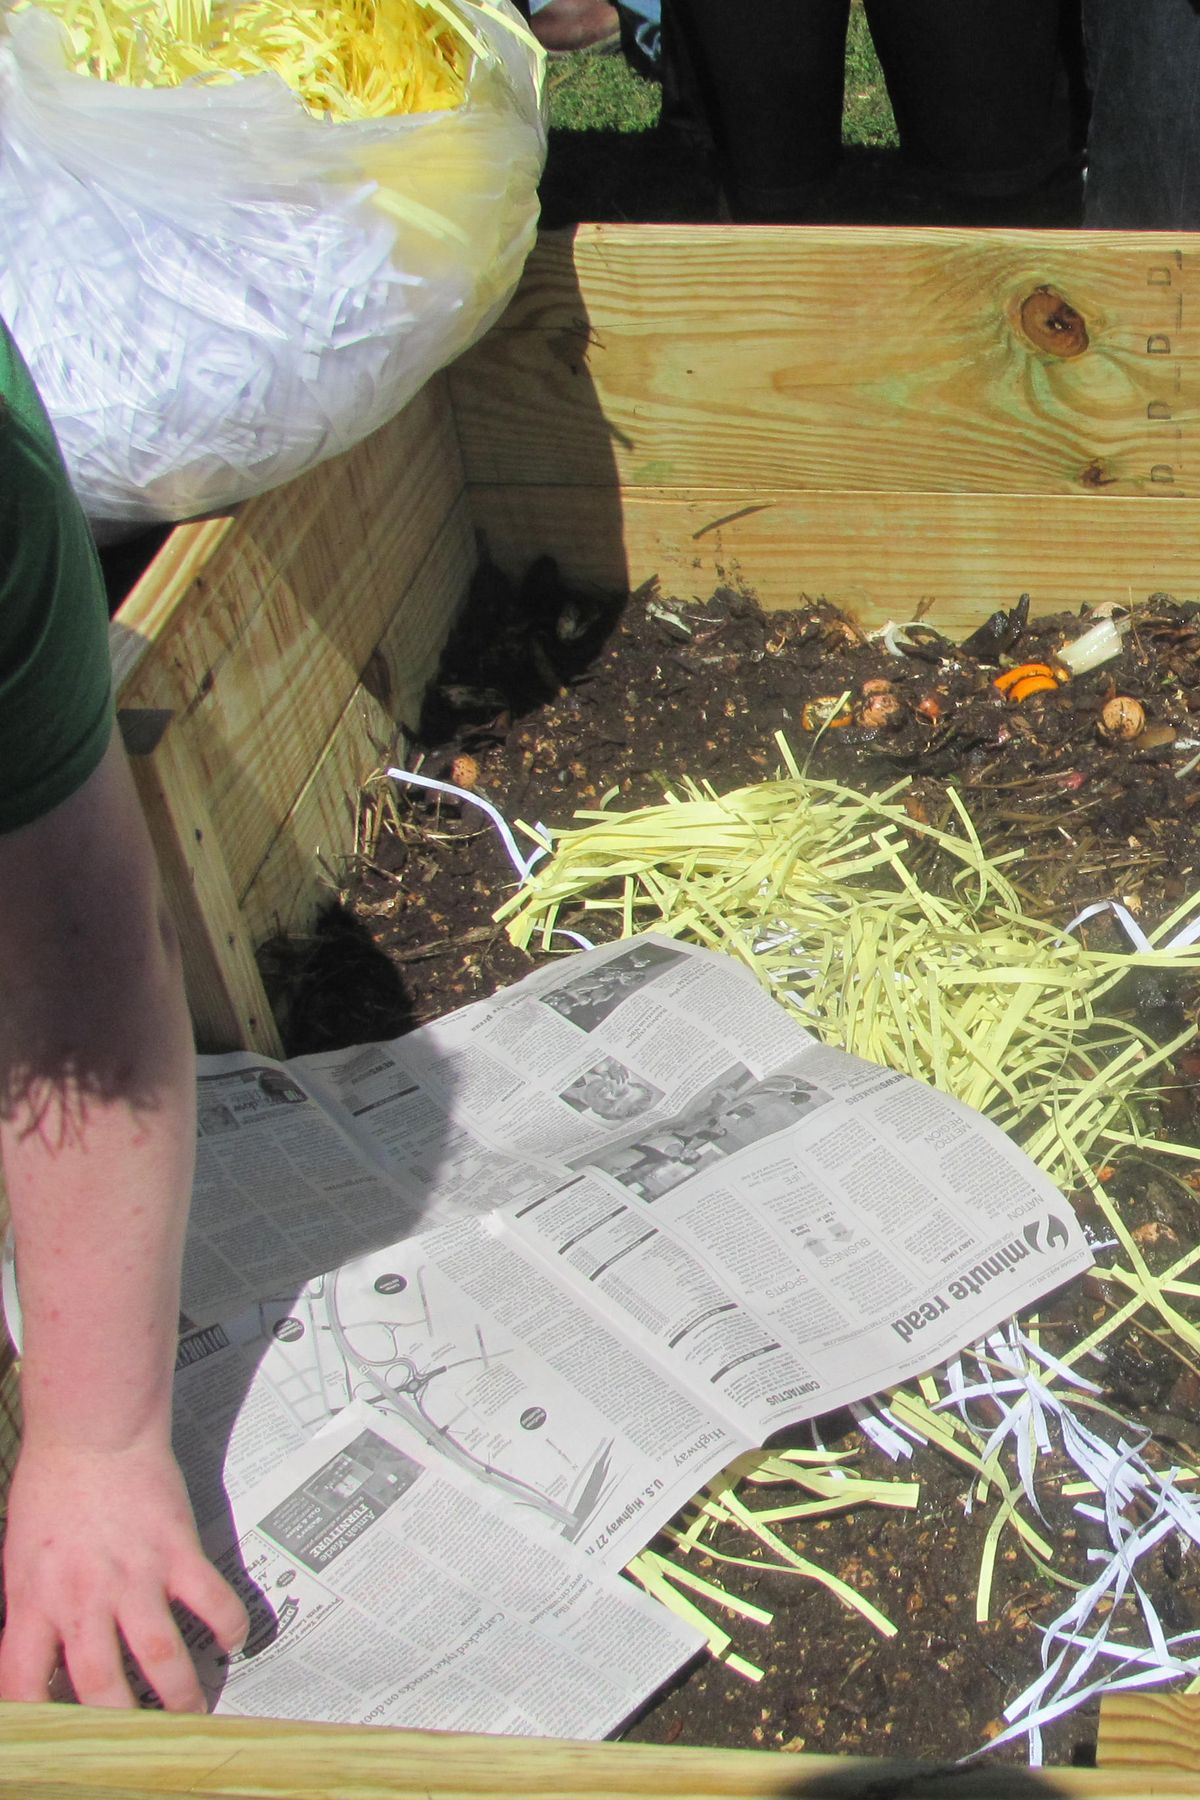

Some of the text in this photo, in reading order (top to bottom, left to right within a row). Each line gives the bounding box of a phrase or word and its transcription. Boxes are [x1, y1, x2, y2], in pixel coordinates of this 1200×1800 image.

[844, 1072, 905, 1106] NEWSMAKERS
[923, 1115, 963, 1143] REGION
[1006, 1193, 1044, 1221] NATION
[818, 1237, 871, 1268] BUSINESS
[763, 1273, 808, 1299] SPORTS
[945, 1237, 1032, 1307] minute
[889, 1293, 951, 1344] read
[765, 1379, 821, 1407] CONTACTUS
[671, 1426, 726, 1467] Highway
[640, 1477, 664, 1501] U.S.
[306, 1506, 321, 1519] Oak
[343, 1509, 376, 1539] Amish
[604, 1496, 644, 1536] Highway
[308, 1502, 368, 1558] FURNITURE
[592, 1532, 609, 1550] 27
[318, 1535, 348, 1563] Made
[454, 1609, 506, 1656] Carjacked
[432, 1649, 459, 1672] tyke
[396, 1666, 439, 1696] knocks
[383, 1692, 400, 1707] on
